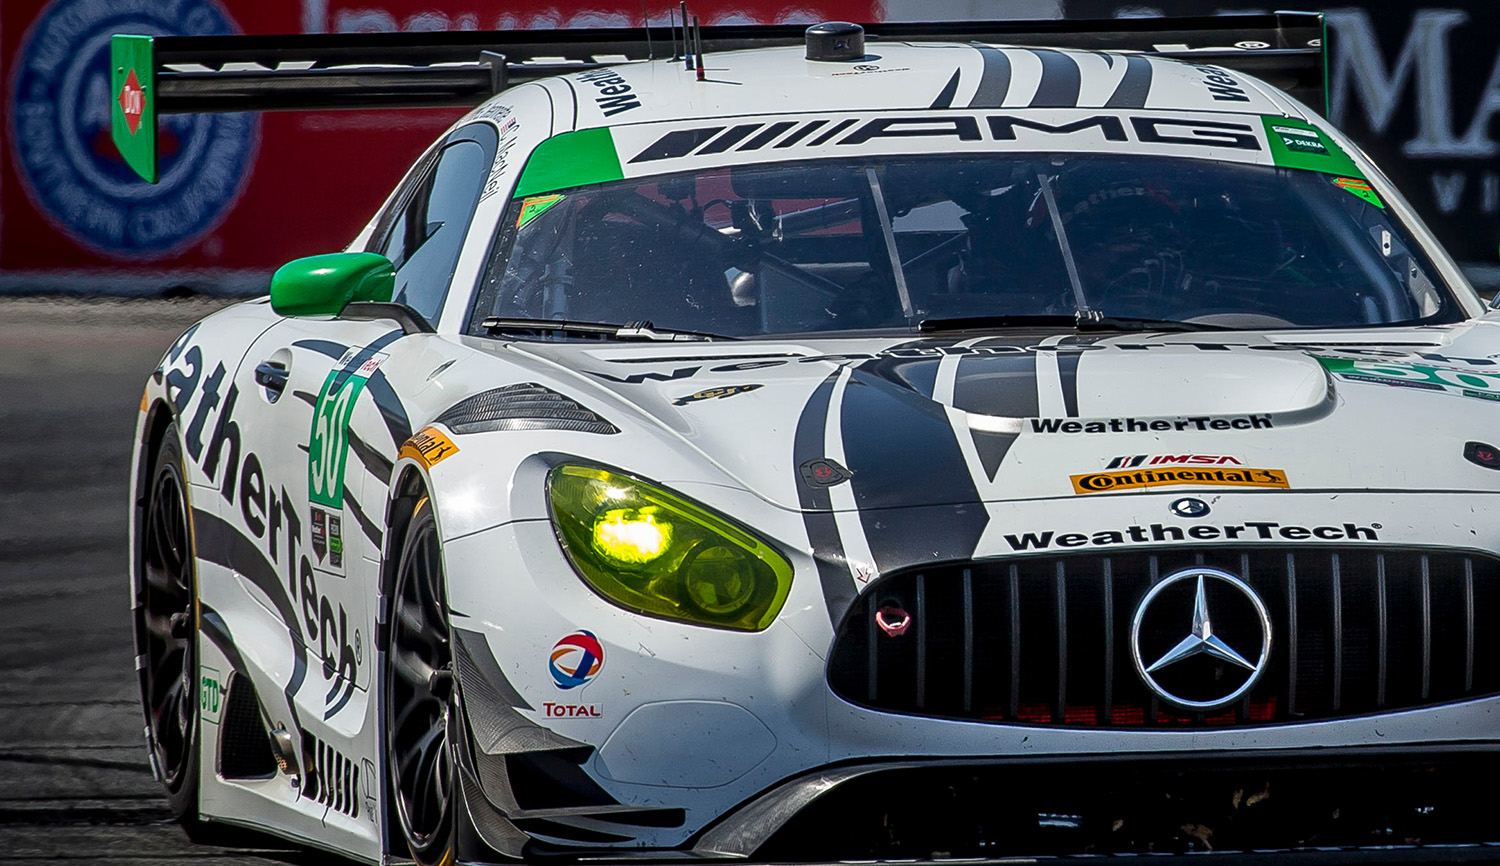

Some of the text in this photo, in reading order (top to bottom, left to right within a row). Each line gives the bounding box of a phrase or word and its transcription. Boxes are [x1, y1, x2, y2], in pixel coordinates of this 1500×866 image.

[836, 115, 1262, 151] AMG
[1294, 139, 1325, 149] DEKRA
[312, 379, 354, 498] 50
[1149, 455, 1243, 465] IMSA
[1079, 470, 1253, 491] Continental
[202, 676, 220, 713] GTD
[543, 702, 601, 717] TOTAL
